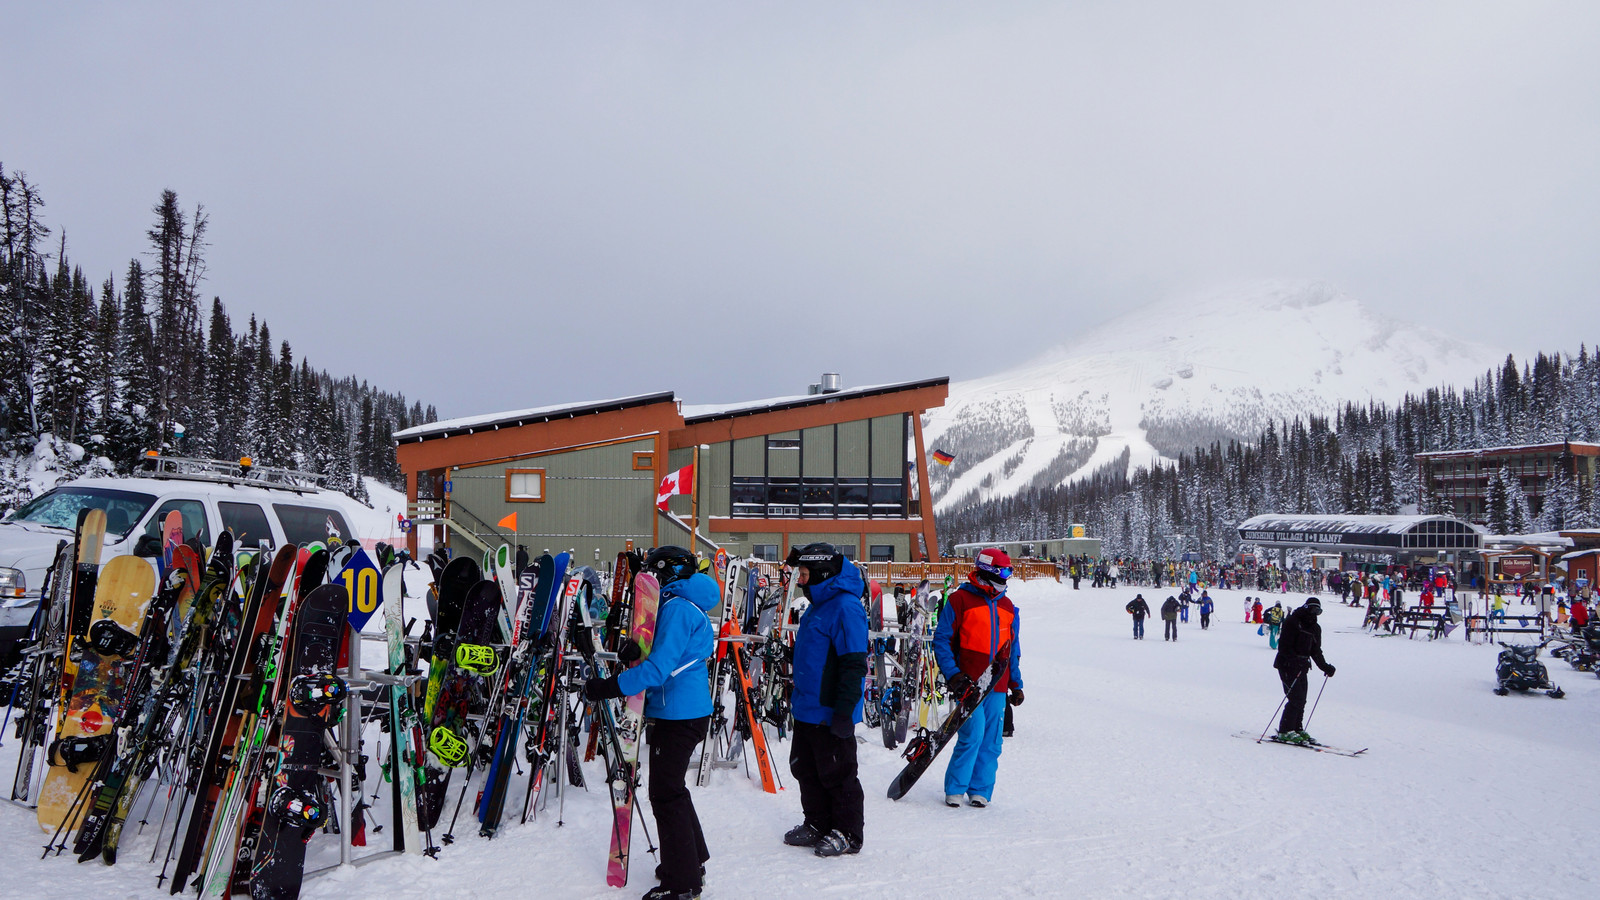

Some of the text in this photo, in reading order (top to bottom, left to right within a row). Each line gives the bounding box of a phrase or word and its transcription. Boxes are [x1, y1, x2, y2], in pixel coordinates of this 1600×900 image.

[1245, 531, 1343, 543] SUNSHINE VILLAGE BANFF
[342, 567, 378, 613] 10
[617, 559, 627, 592] HEAD
[724, 565, 737, 622] HEAD
